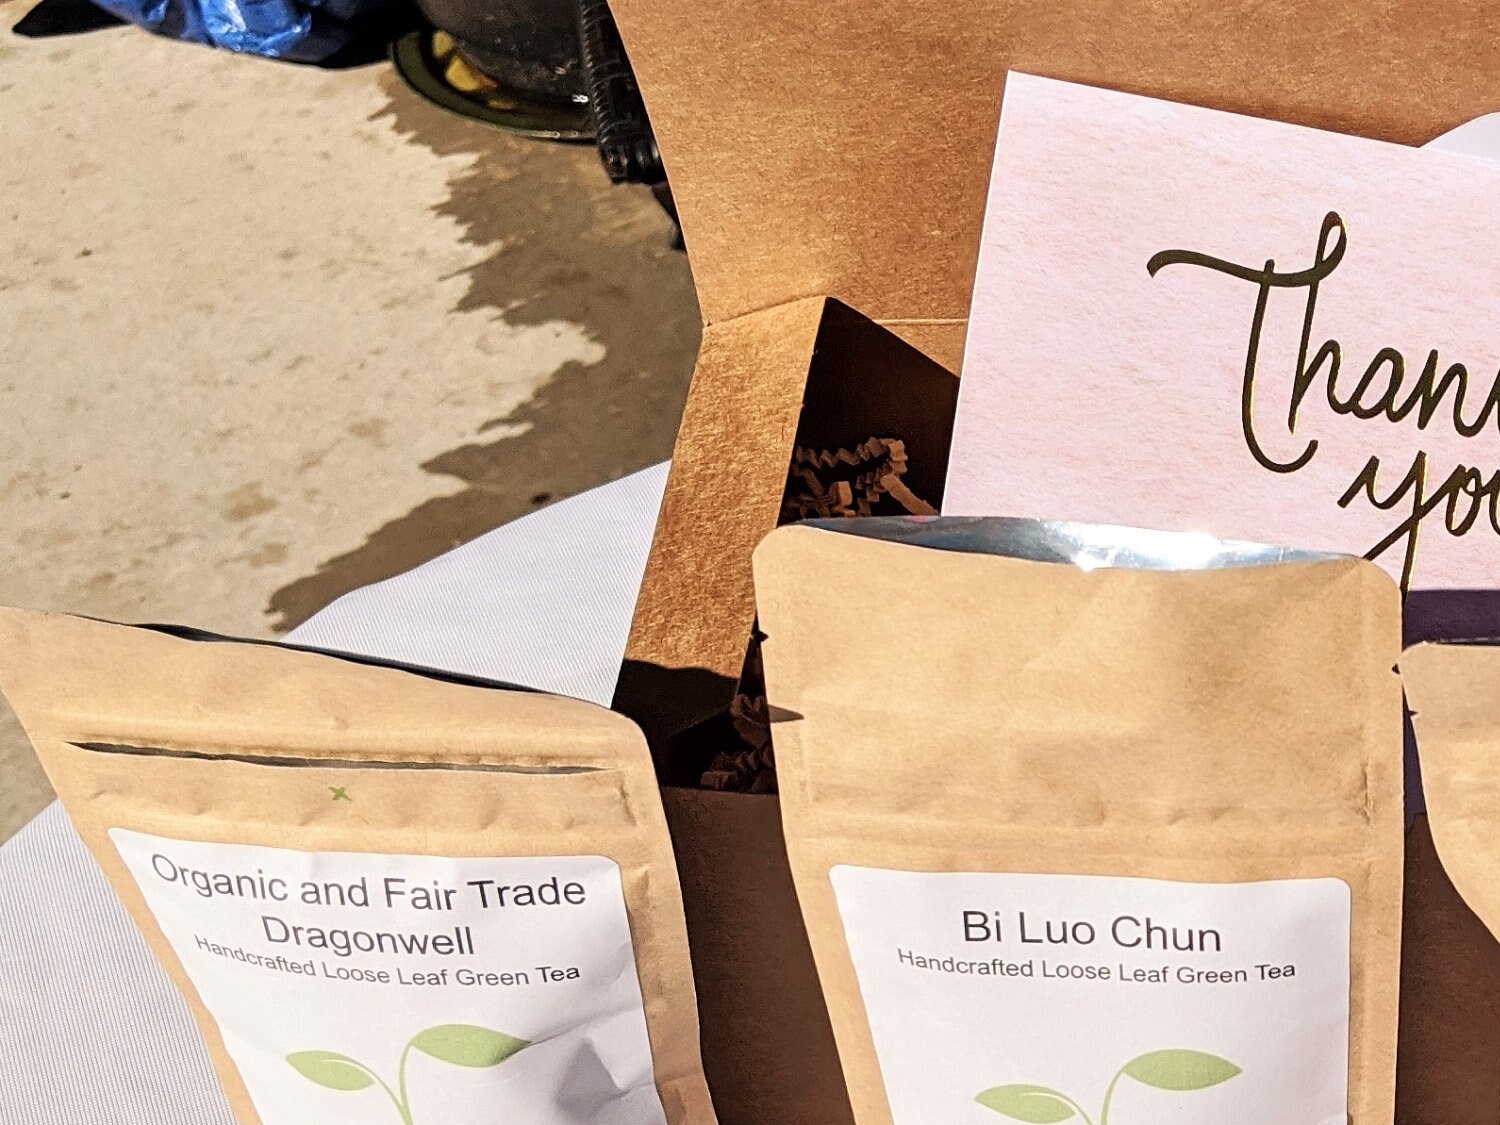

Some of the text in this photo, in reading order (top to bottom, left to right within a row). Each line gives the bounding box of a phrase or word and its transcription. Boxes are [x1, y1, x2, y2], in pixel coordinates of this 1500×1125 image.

[152, 854, 585, 910] Organic and Fair Trade
[262, 916, 474, 957] Dragonwell
[963, 911, 1220, 951] Bi Luo Chun
[195, 933, 581, 986] Handcrafted Loose Leaf Green Tea
[898, 949, 1296, 984] Handcrafted Loose Leaf Green Tea
